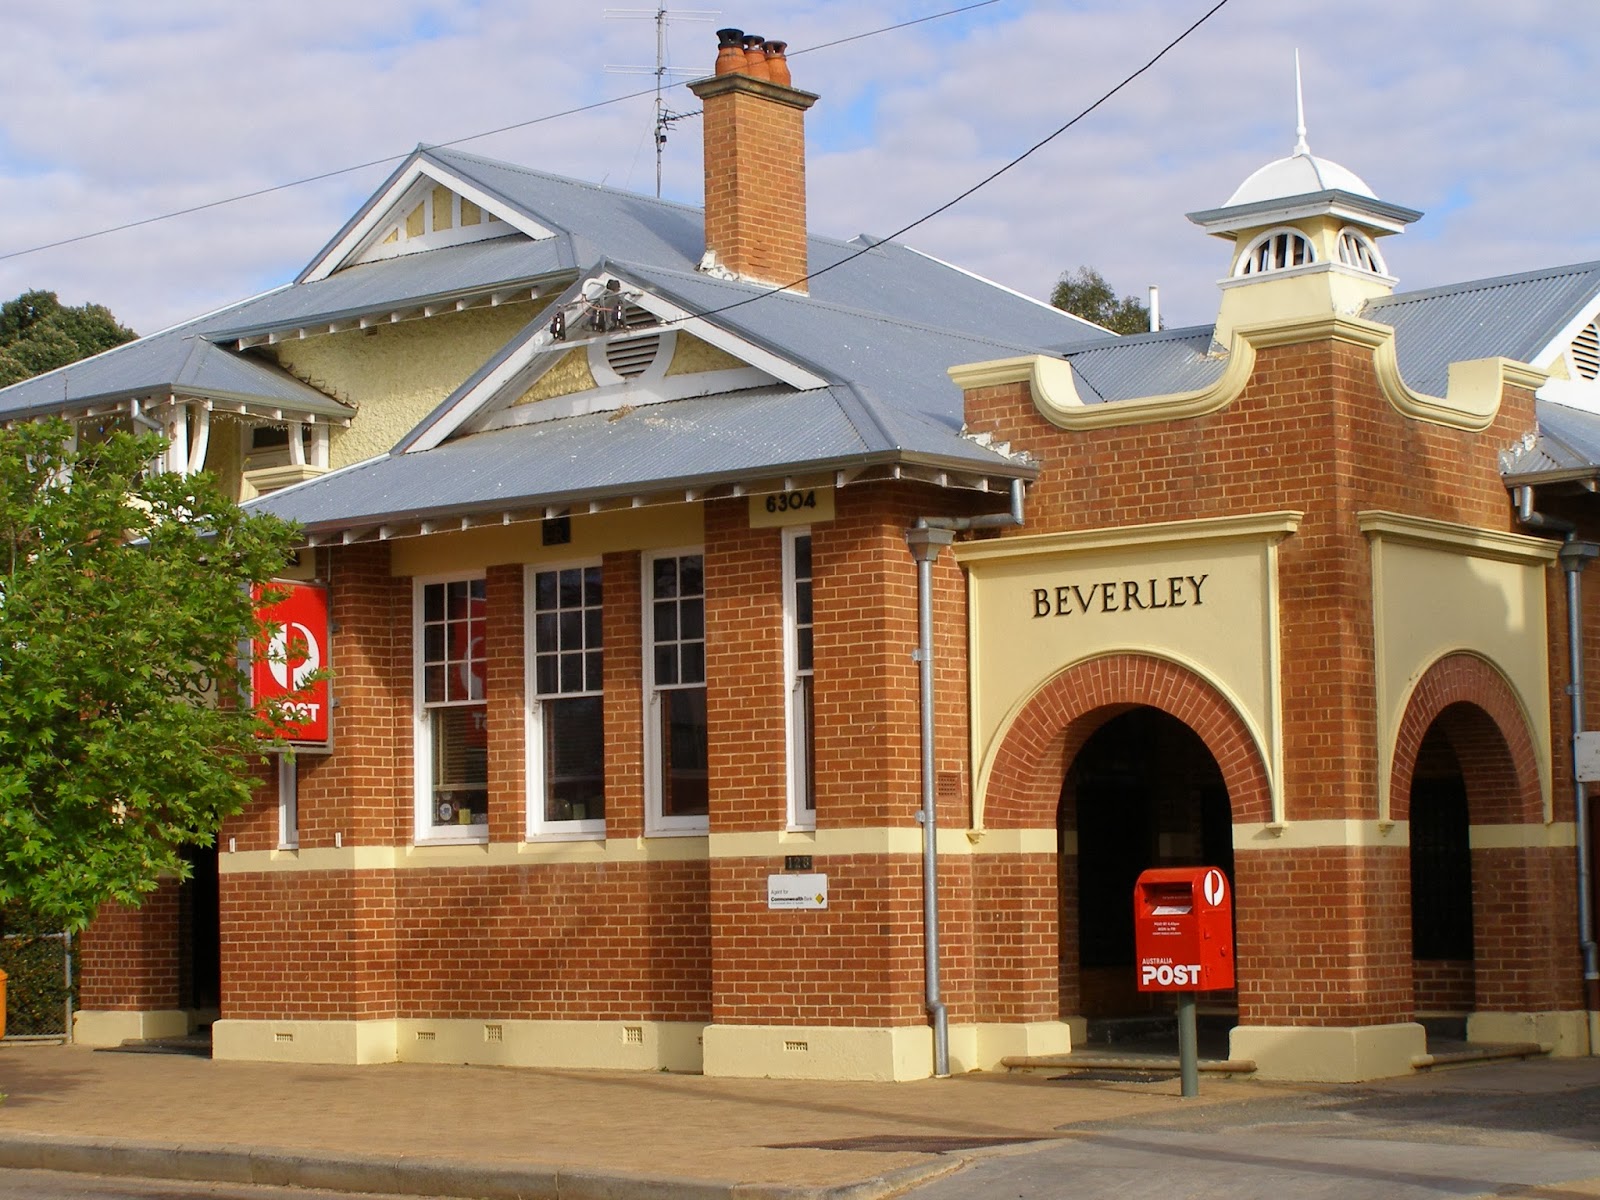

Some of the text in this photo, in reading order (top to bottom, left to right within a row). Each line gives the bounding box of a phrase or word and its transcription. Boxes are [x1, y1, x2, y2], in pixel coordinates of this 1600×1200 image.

[766, 490, 816, 512] 6304
[1032, 574, 1209, 619] BEVERLEY
[1142, 964, 1201, 986] POST
